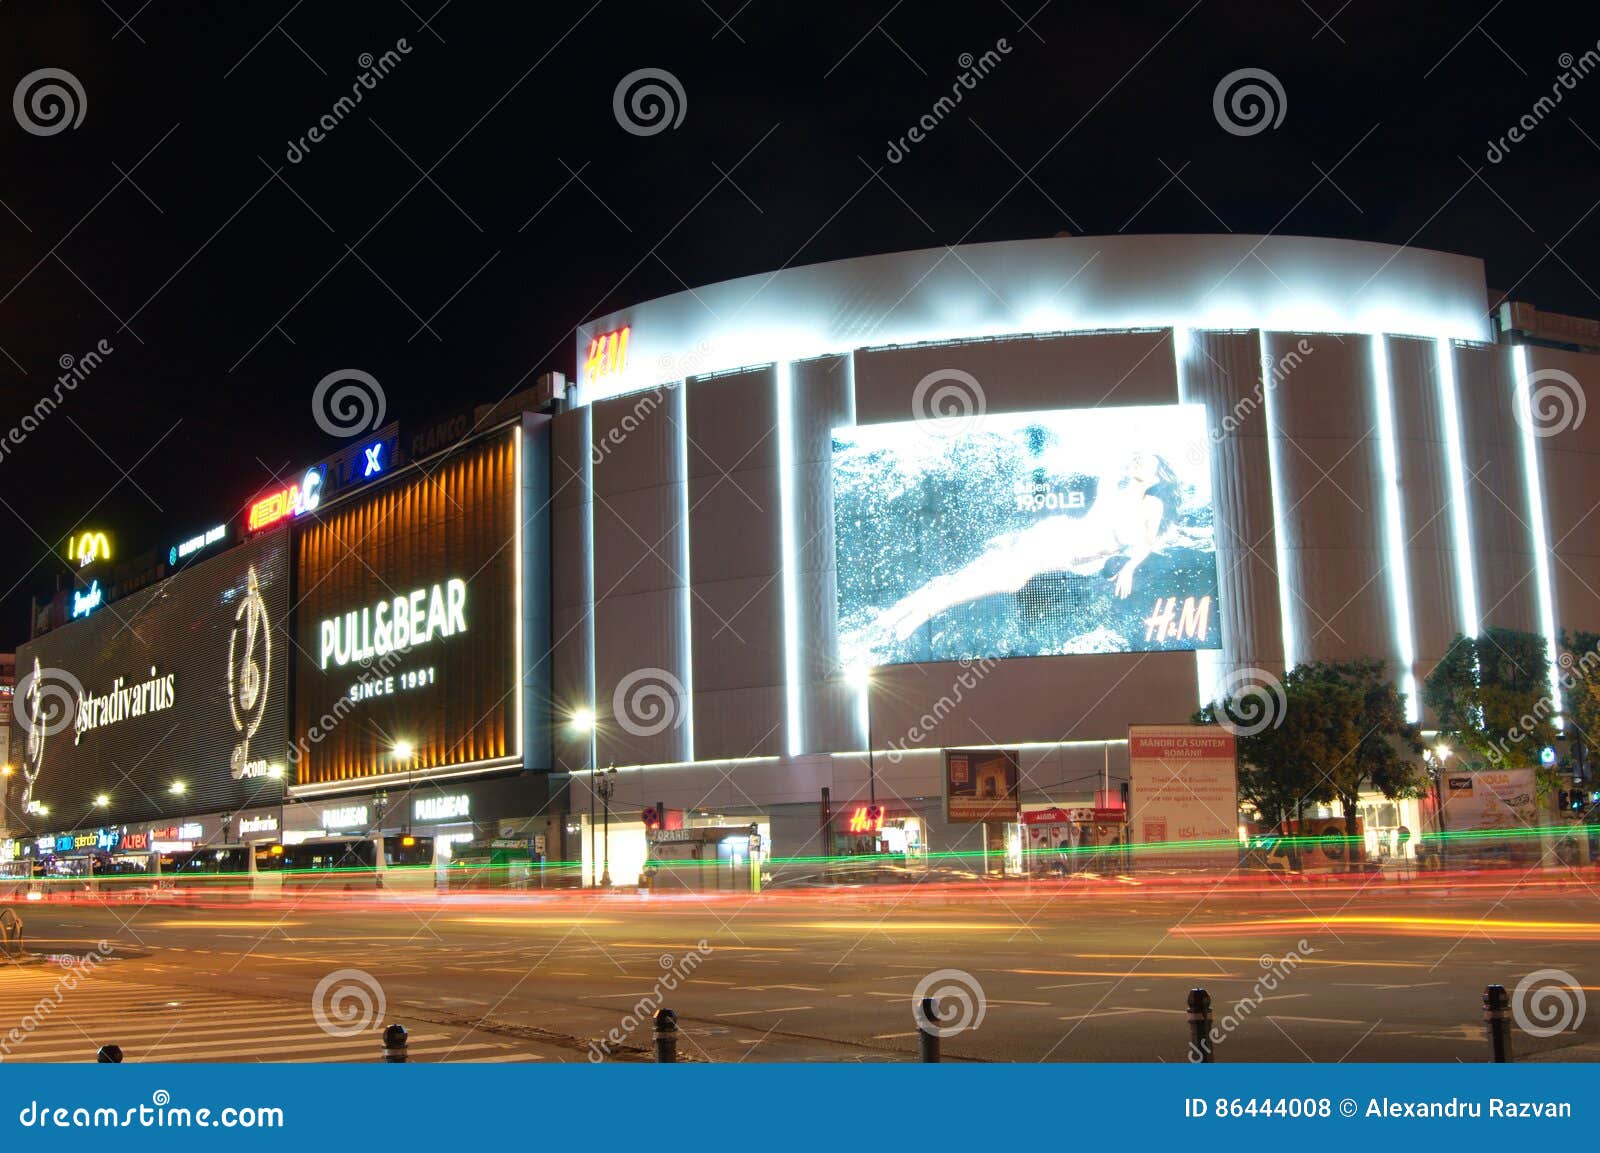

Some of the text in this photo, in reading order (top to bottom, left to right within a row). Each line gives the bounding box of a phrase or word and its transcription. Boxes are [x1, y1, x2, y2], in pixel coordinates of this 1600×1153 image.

[321, 578, 467, 670] PULL&BEAR
[1144, 596, 1211, 642] H&M
[350, 667, 435, 702] SINCE 1991
